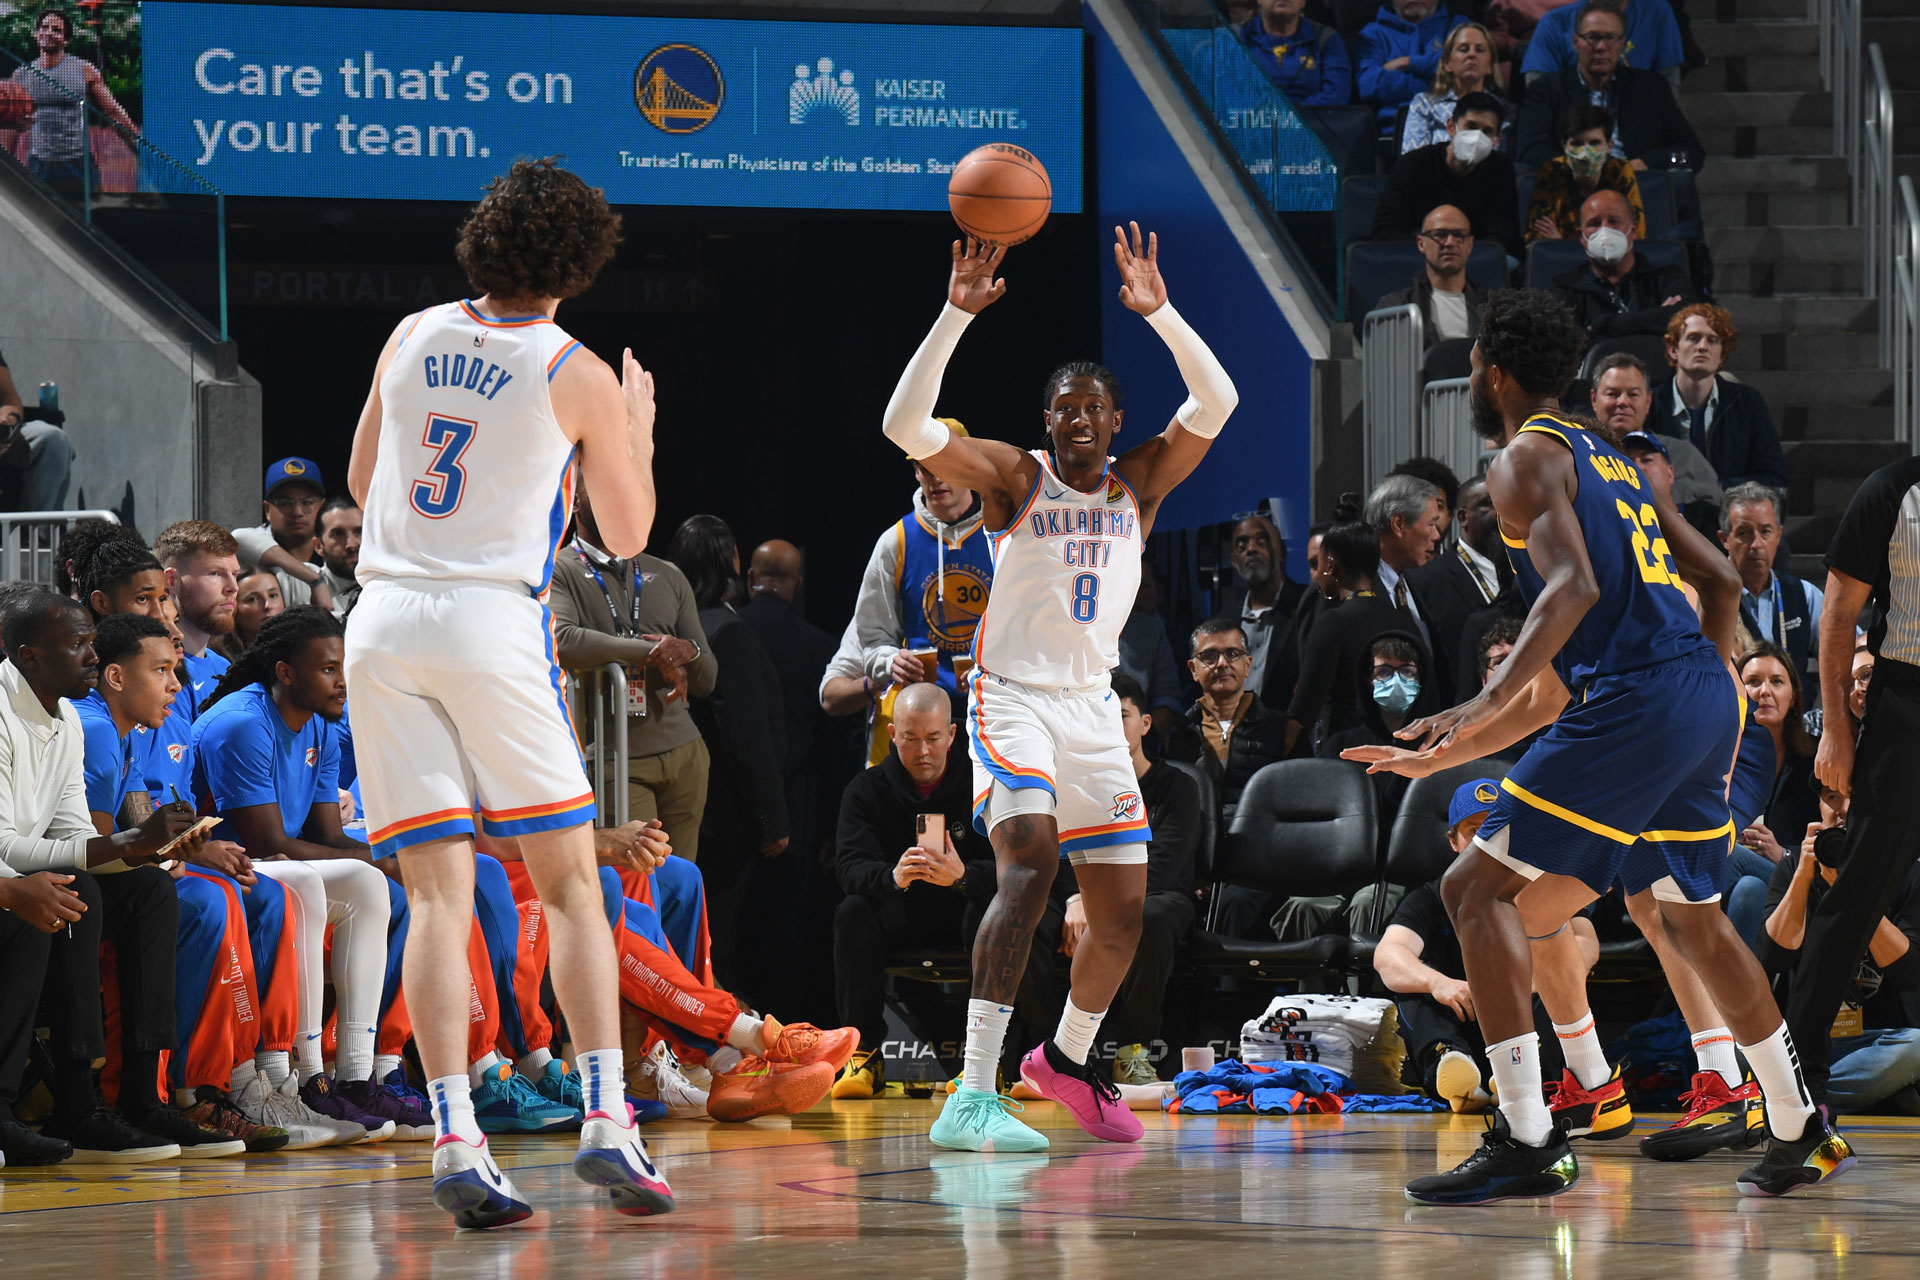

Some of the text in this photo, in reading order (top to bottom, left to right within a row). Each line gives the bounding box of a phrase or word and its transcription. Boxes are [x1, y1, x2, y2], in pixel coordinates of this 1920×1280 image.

[195, 48, 322, 97] Care
[506, 72, 573, 104] on
[875, 79, 945, 98] KAISER
[193, 114, 490, 166] your team.
[619, 151, 679, 168] Trusted
[681, 152, 724, 169] Team
[728, 153, 808, 172] Physicians
[812, 156, 829, 172] of
[832, 156, 857, 172] the
[862, 156, 922, 173] Golden
[253, 271, 440, 303] PORTAL A
[425, 353, 513, 401] GIDDEY
[409, 411, 478, 519] 3
[1030, 507, 1135, 540] OKLAHMA
[1064, 539, 1111, 568] CITY
[1616, 498, 1686, 594] 22
[920, 562, 959, 588] GOLEN
[956, 584, 982, 604] 30
[1070, 571, 1100, 625] 8
[1114, 796, 1138, 816] OKC
[230, 965, 245, 985] CITY
[621, 953, 706, 1017] OKLAHOMA CITY THUNDER
[231, 984, 254, 1024] THUNDER
